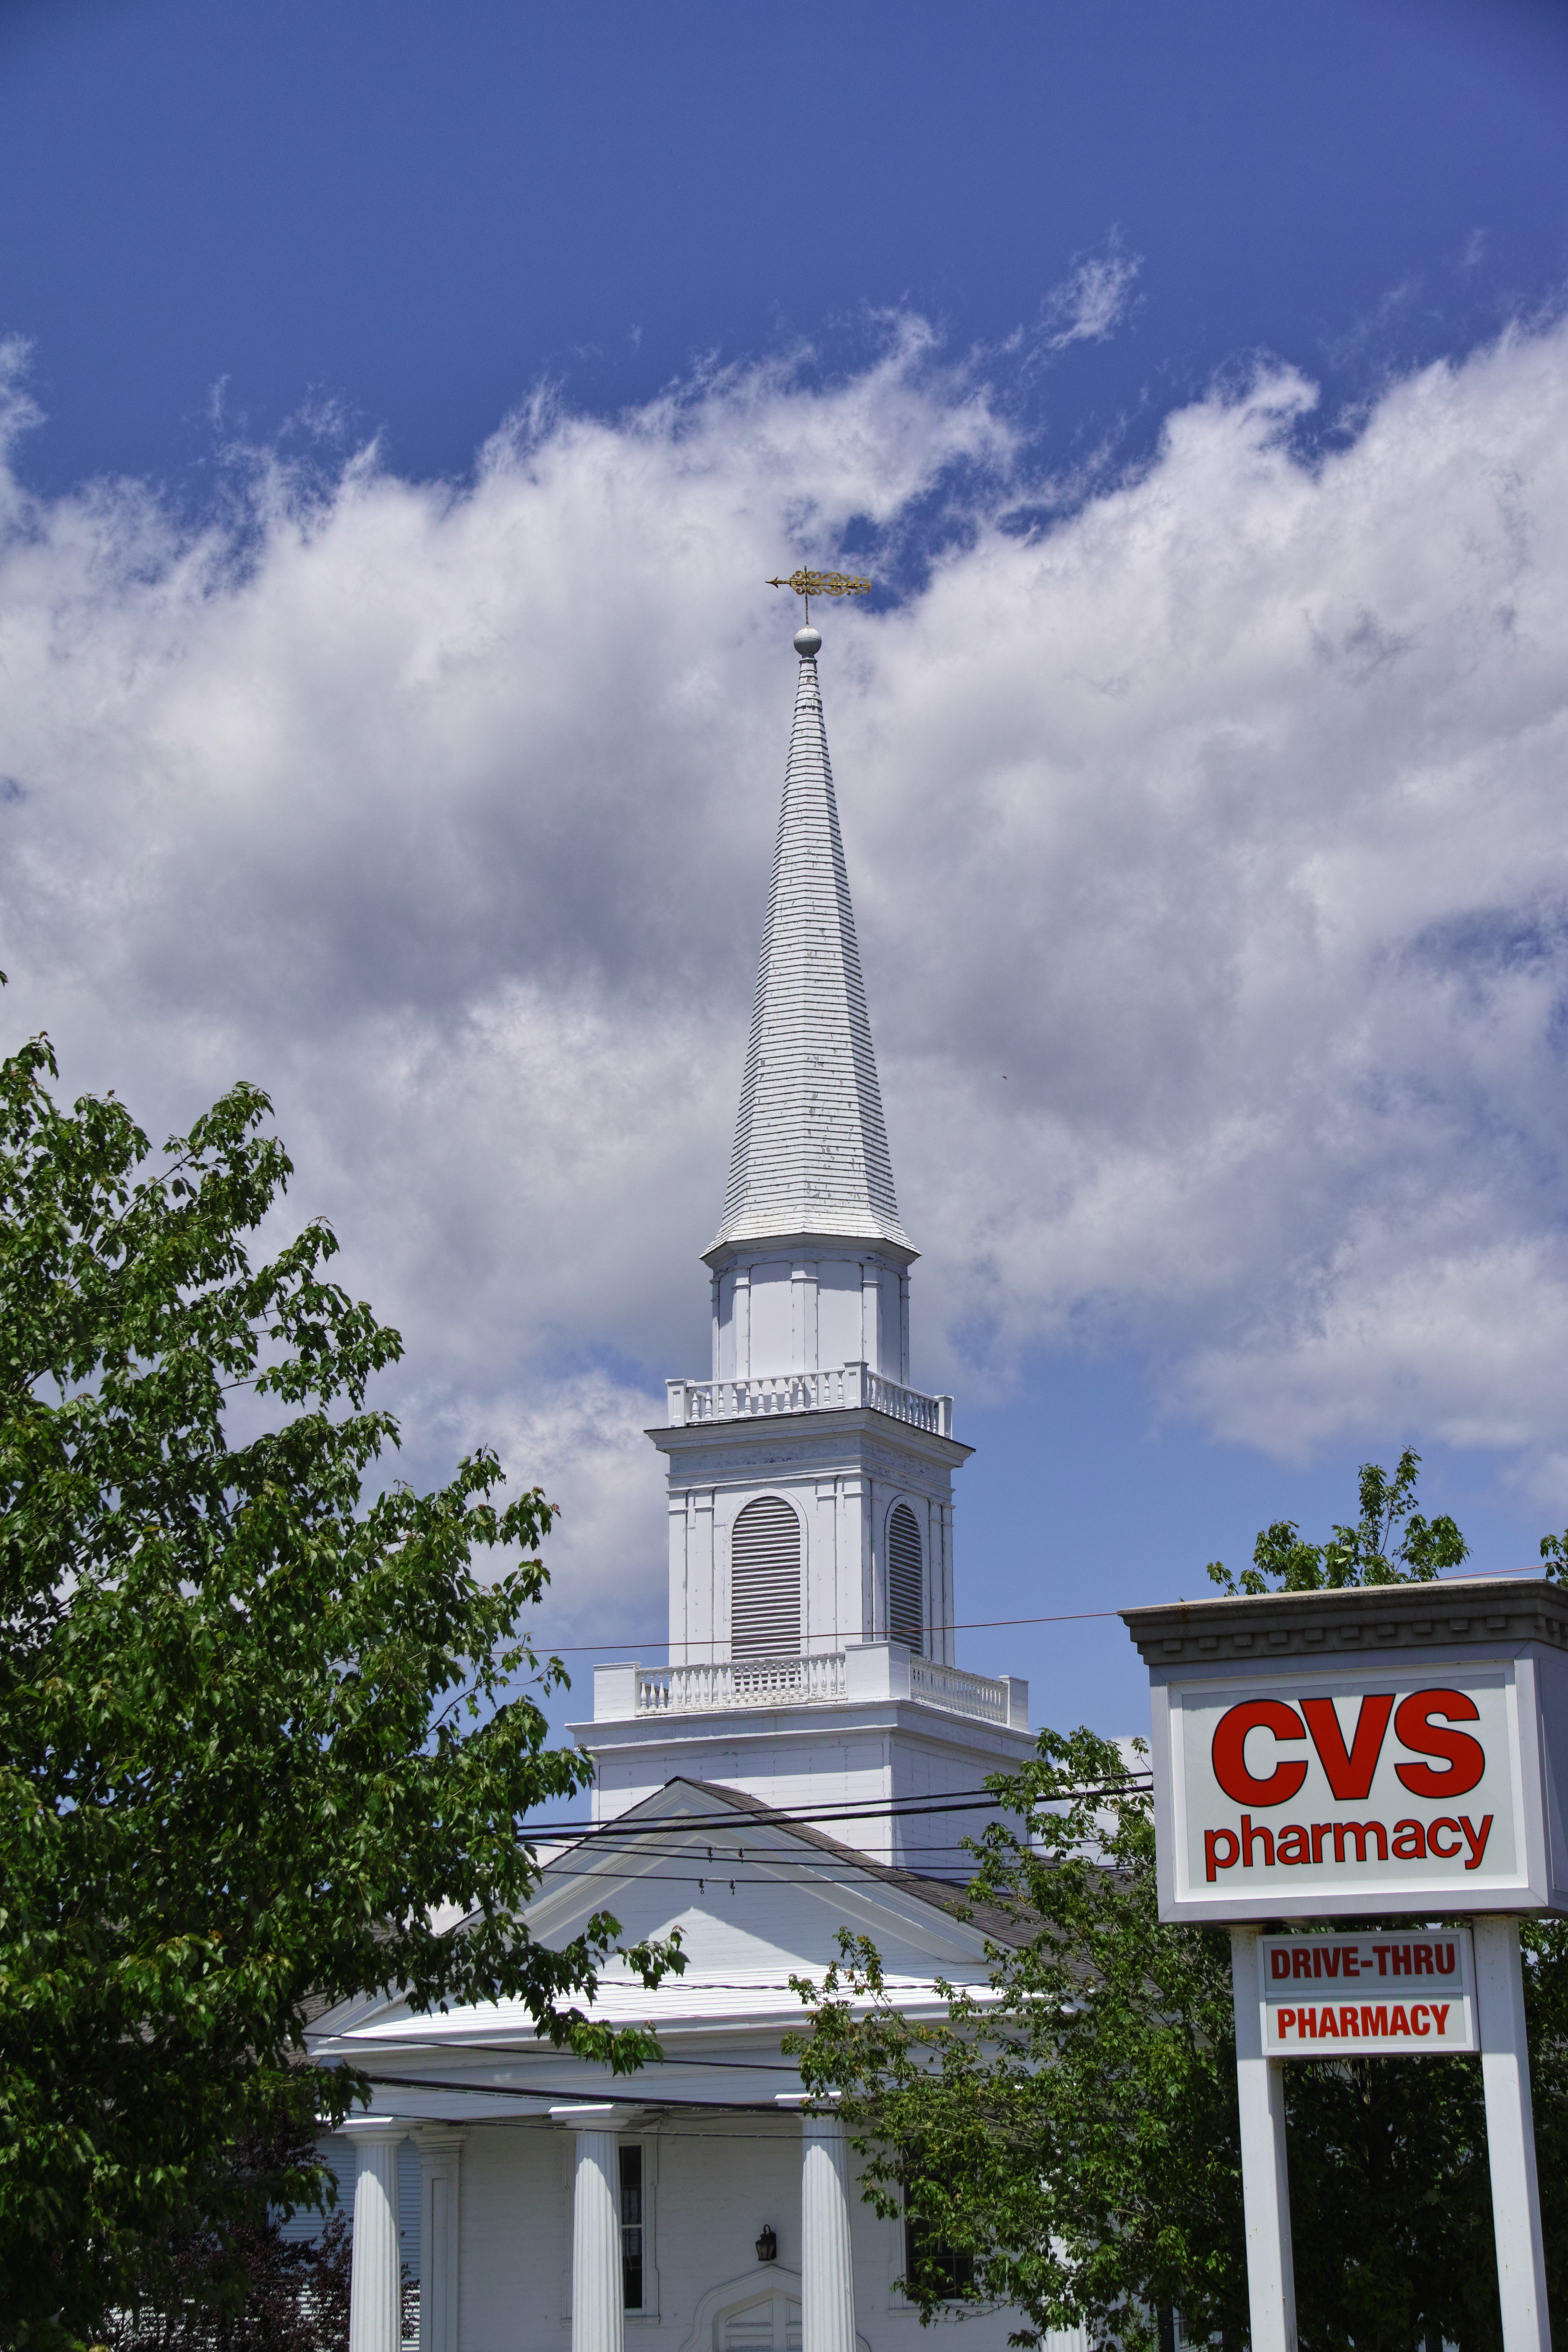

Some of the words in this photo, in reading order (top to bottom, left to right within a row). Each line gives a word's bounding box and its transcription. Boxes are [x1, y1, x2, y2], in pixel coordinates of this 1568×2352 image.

[1212, 1688, 1485, 1807] CVS
[1204, 1814, 1494, 1882] pharmacy
[1270, 1943, 1456, 1978] DRIVE-THRU
[1277, 2004, 1450, 2038] PHARMACY
